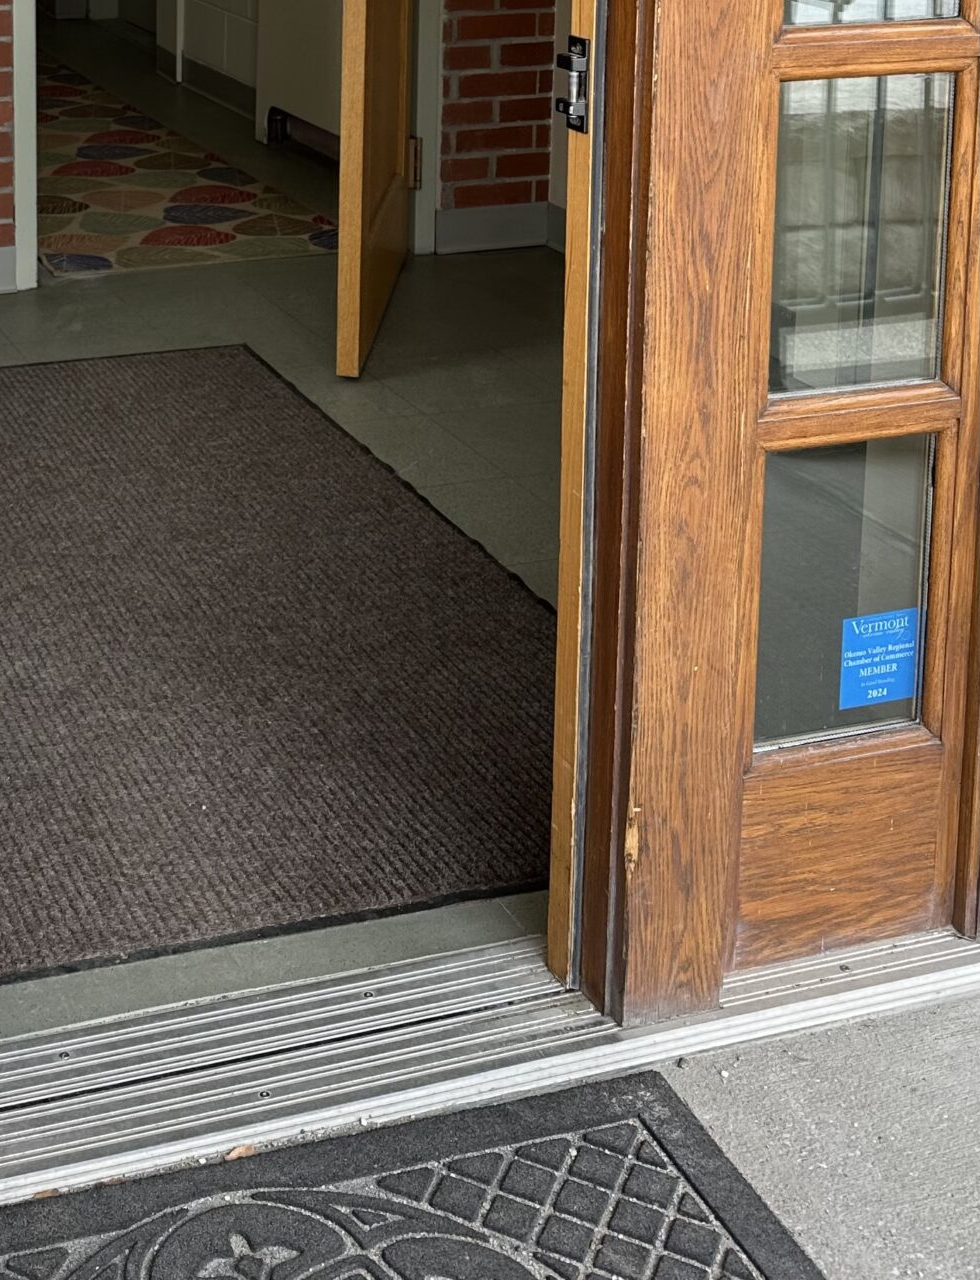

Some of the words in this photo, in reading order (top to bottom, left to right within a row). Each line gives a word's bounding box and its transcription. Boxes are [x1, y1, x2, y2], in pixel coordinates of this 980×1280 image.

[852, 616, 909, 635] Vermont
[844, 650, 867, 659] Okemo
[868, 645, 887, 655] Valley
[887, 640, 915, 652] Regional
[843, 657, 872, 667] Chamber
[881, 650, 914, 661] Commerce
[859, 663, 898, 677] MEMBER
[867, 687, 887, 699] 2024
